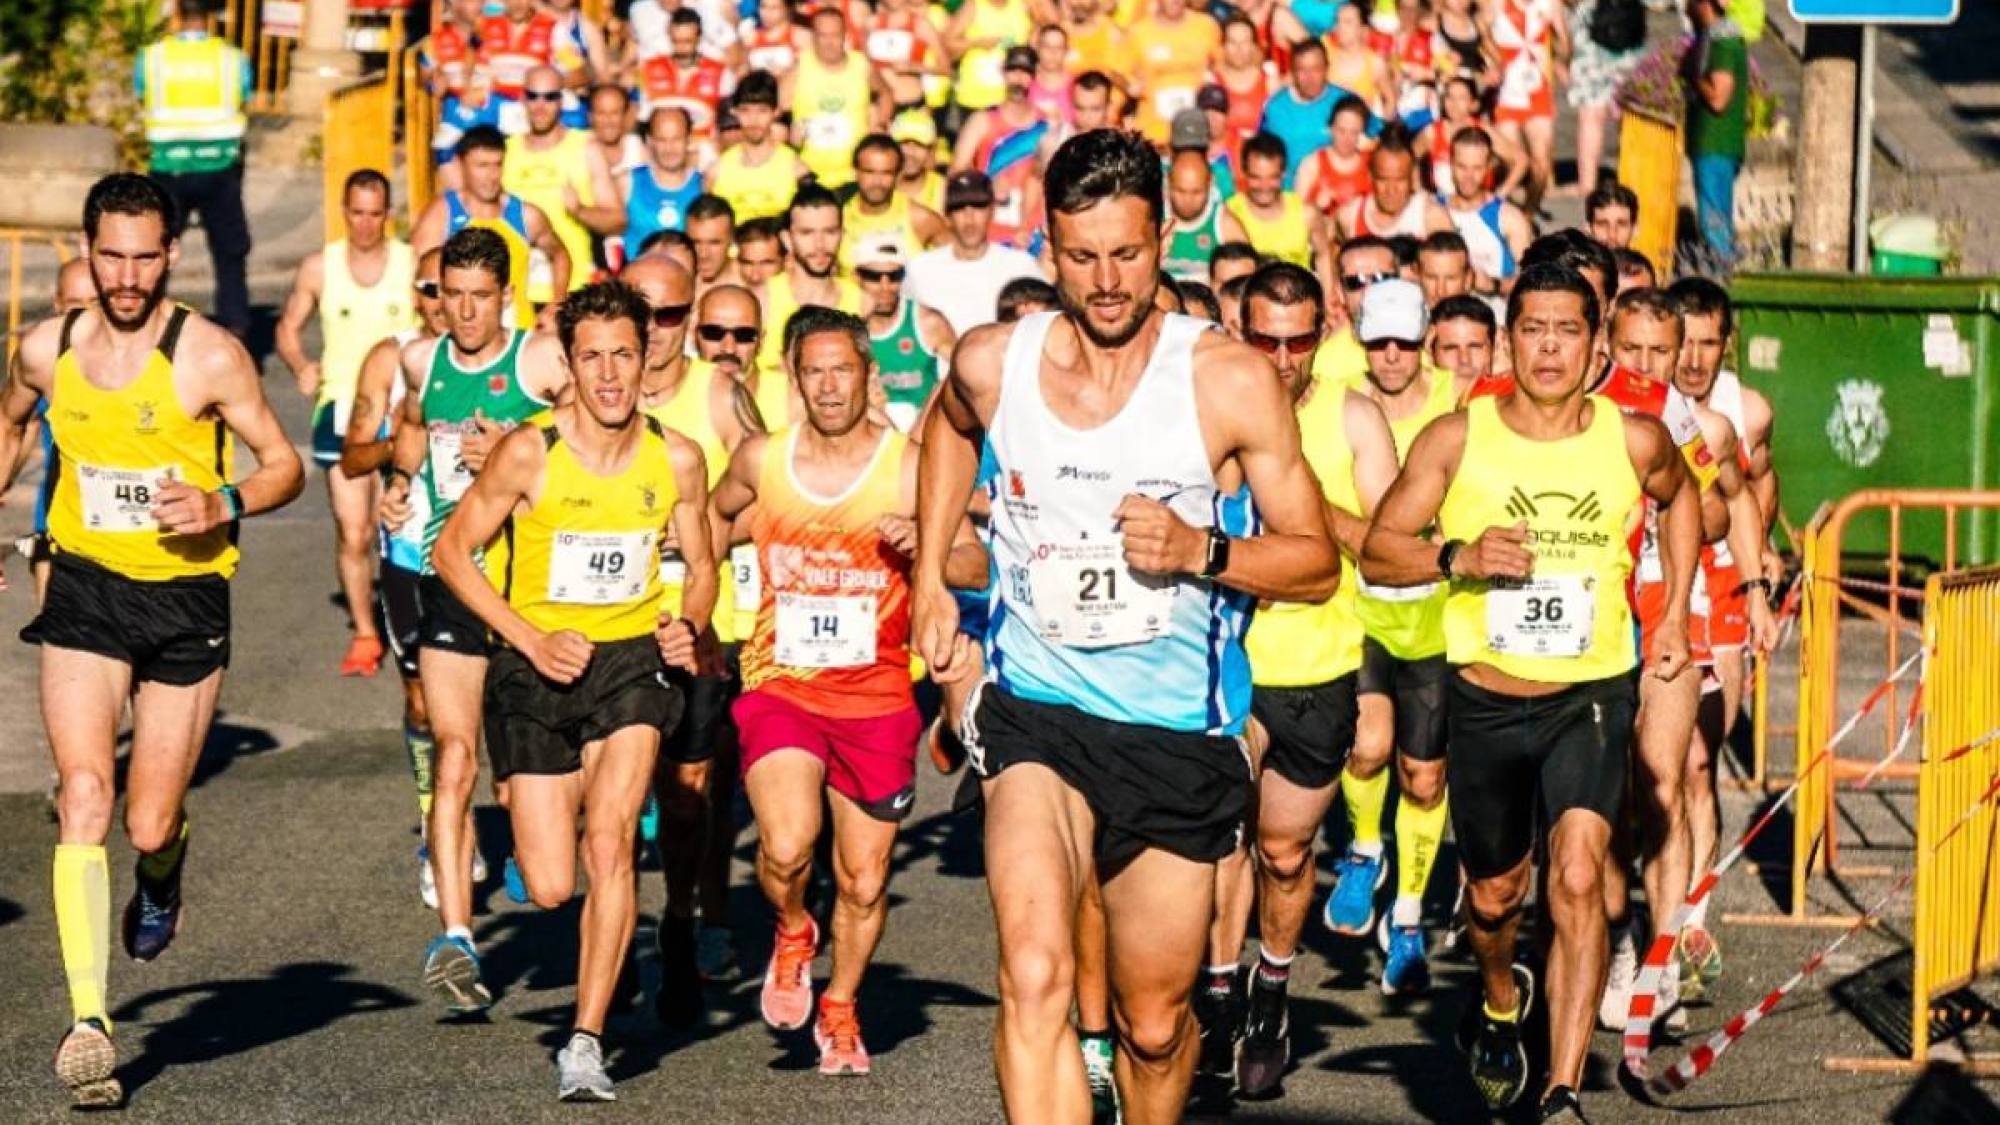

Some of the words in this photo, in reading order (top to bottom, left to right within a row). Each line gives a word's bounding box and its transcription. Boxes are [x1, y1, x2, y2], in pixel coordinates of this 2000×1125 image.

[114, 484, 150, 505] 48
[588, 551, 625, 574] 49
[1079, 567, 1117, 602] 21
[1524, 596, 1564, 622] 36
[809, 614, 838, 638] 14
